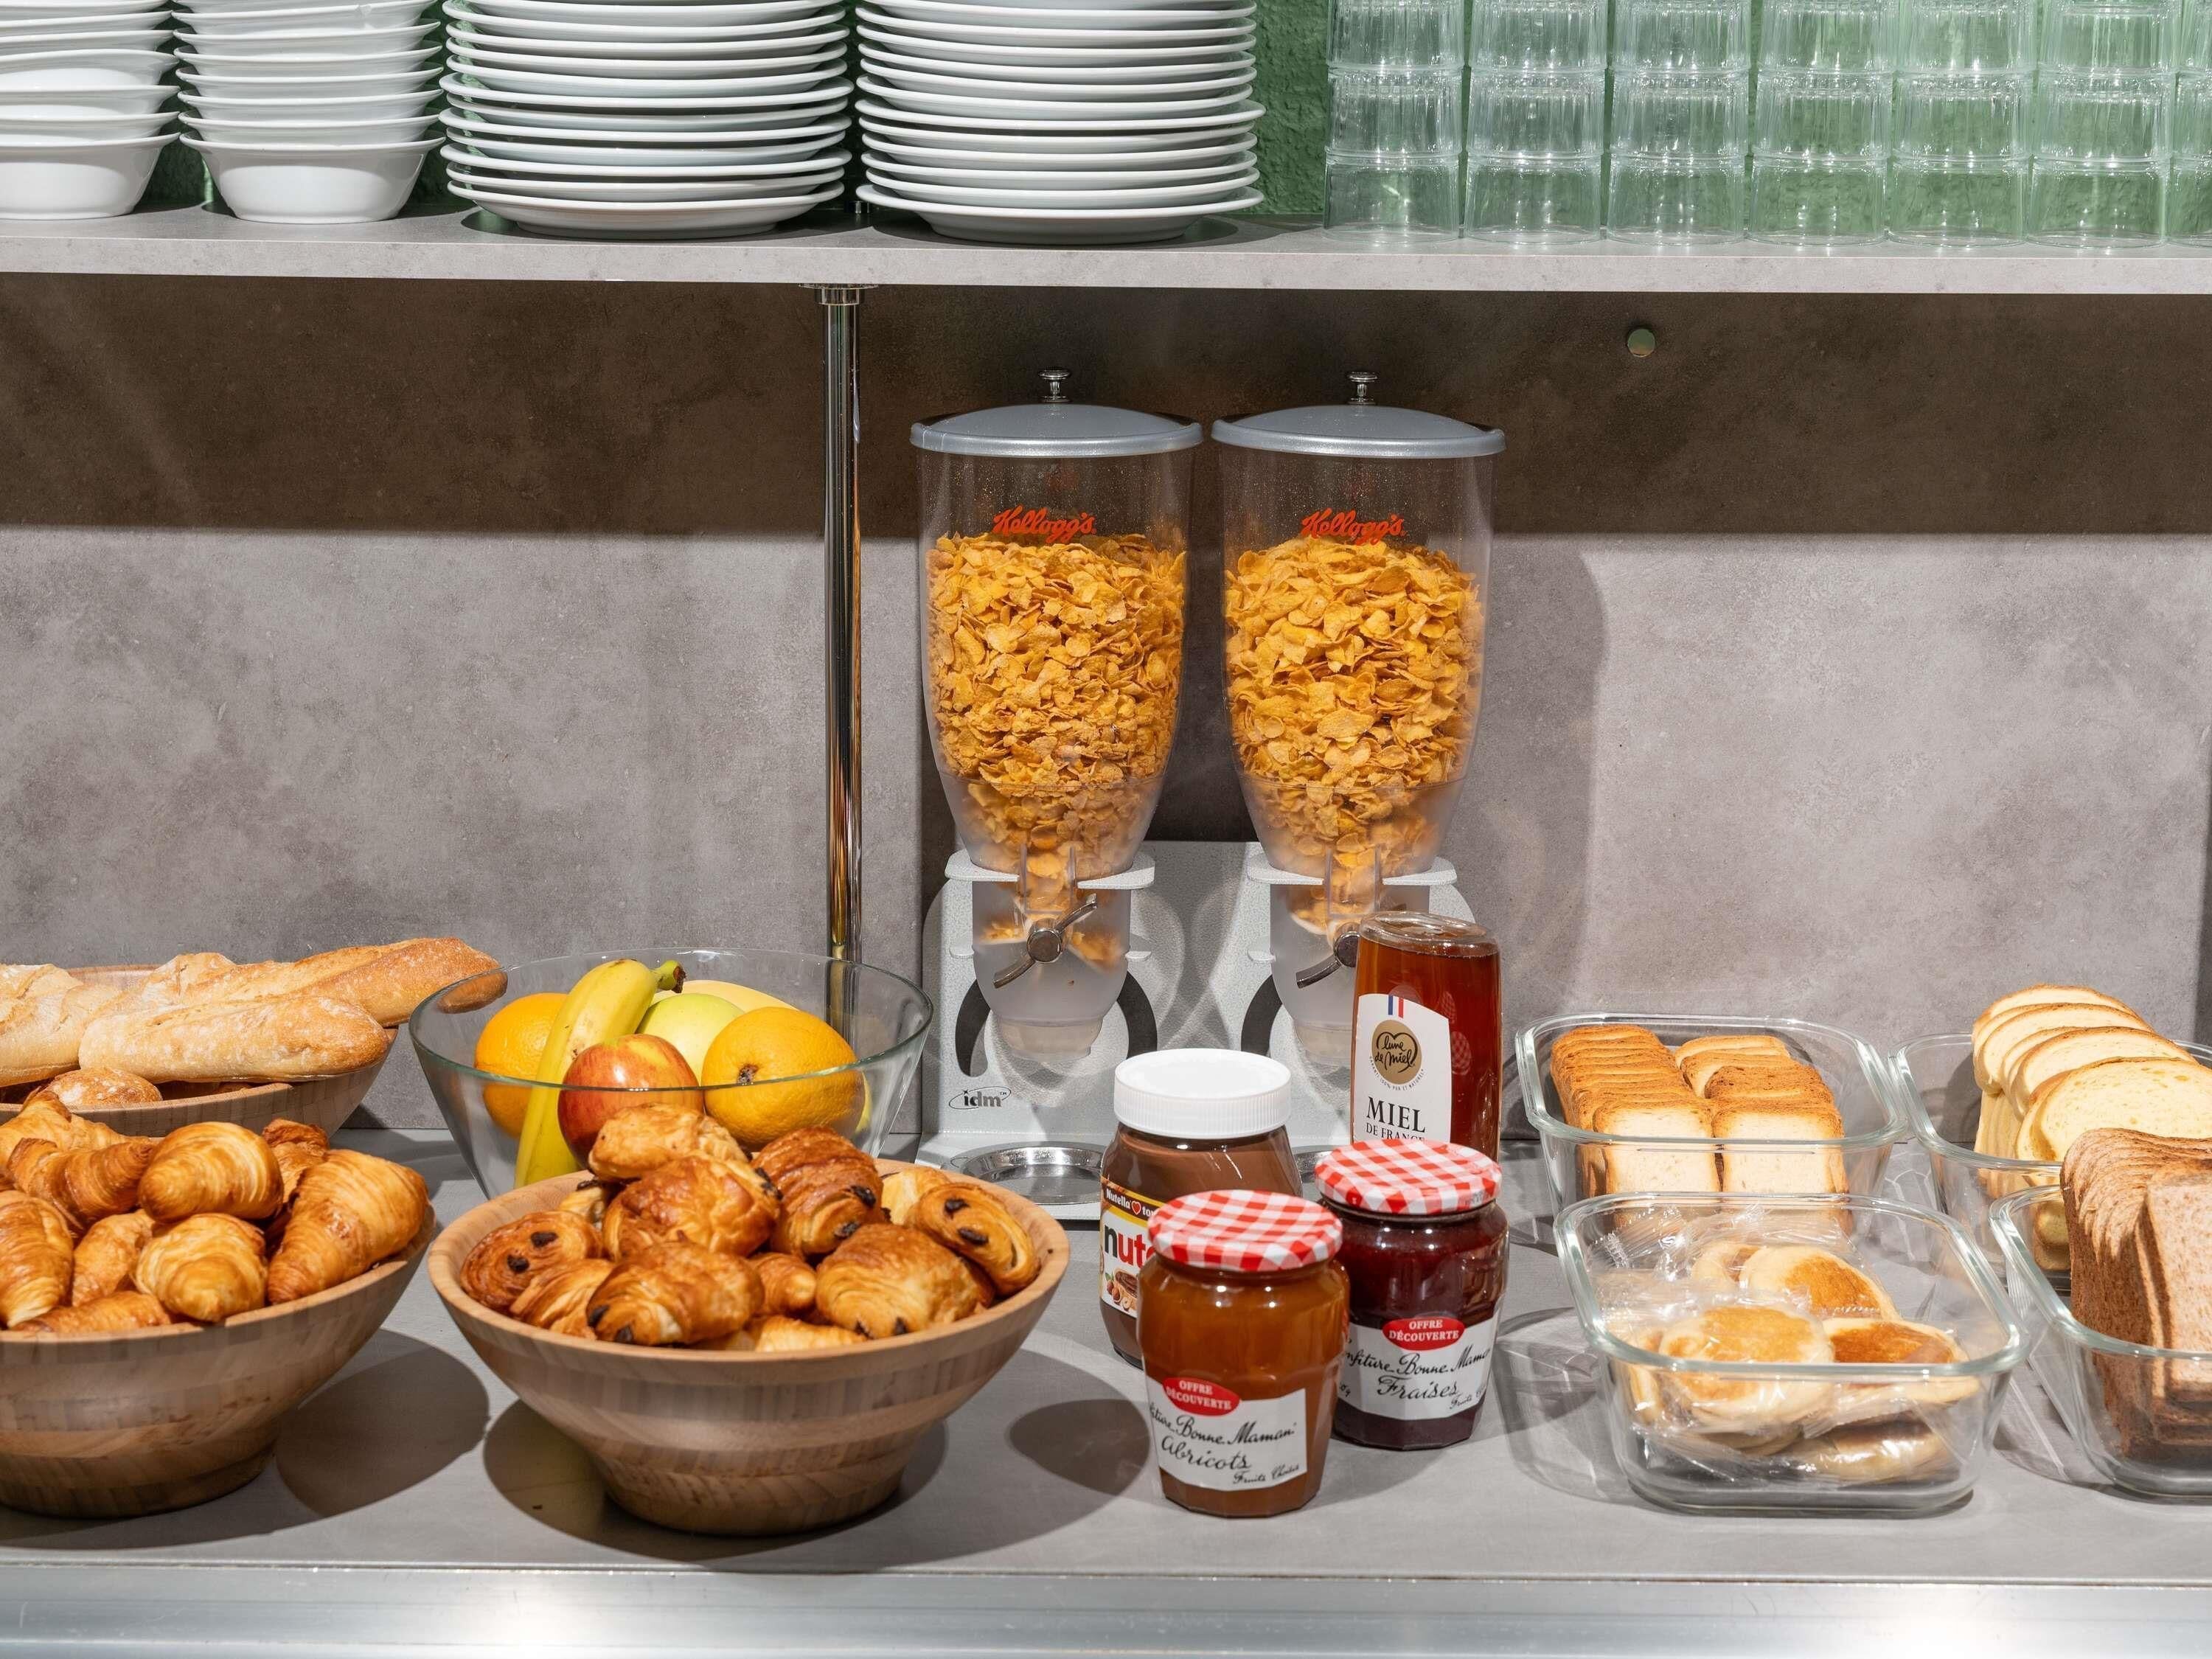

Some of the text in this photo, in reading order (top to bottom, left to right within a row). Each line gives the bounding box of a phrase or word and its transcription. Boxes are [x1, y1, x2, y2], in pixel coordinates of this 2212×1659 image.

[992, 504, 1096, 543] Kellogg's
[1301, 507, 1405, 546] Kellogg's
[1366, 1096, 1426, 1133] MIEL
[1366, 1122, 1378, 1136] DE
[1106, 1188, 1130, 1209] Nutella
[1105, 1225, 1156, 1268] nut
[1389, 1330, 1459, 1342] DÉCOUVERTE
[1409, 1319, 1443, 1330] OFFRE
[1397, 1353, 1448, 1376] Bonne
[1179, 1380, 1213, 1395] OFFRE
[1377, 1375, 1458, 1400] Fraises
[1174, 1414, 1225, 1444] Bonne
